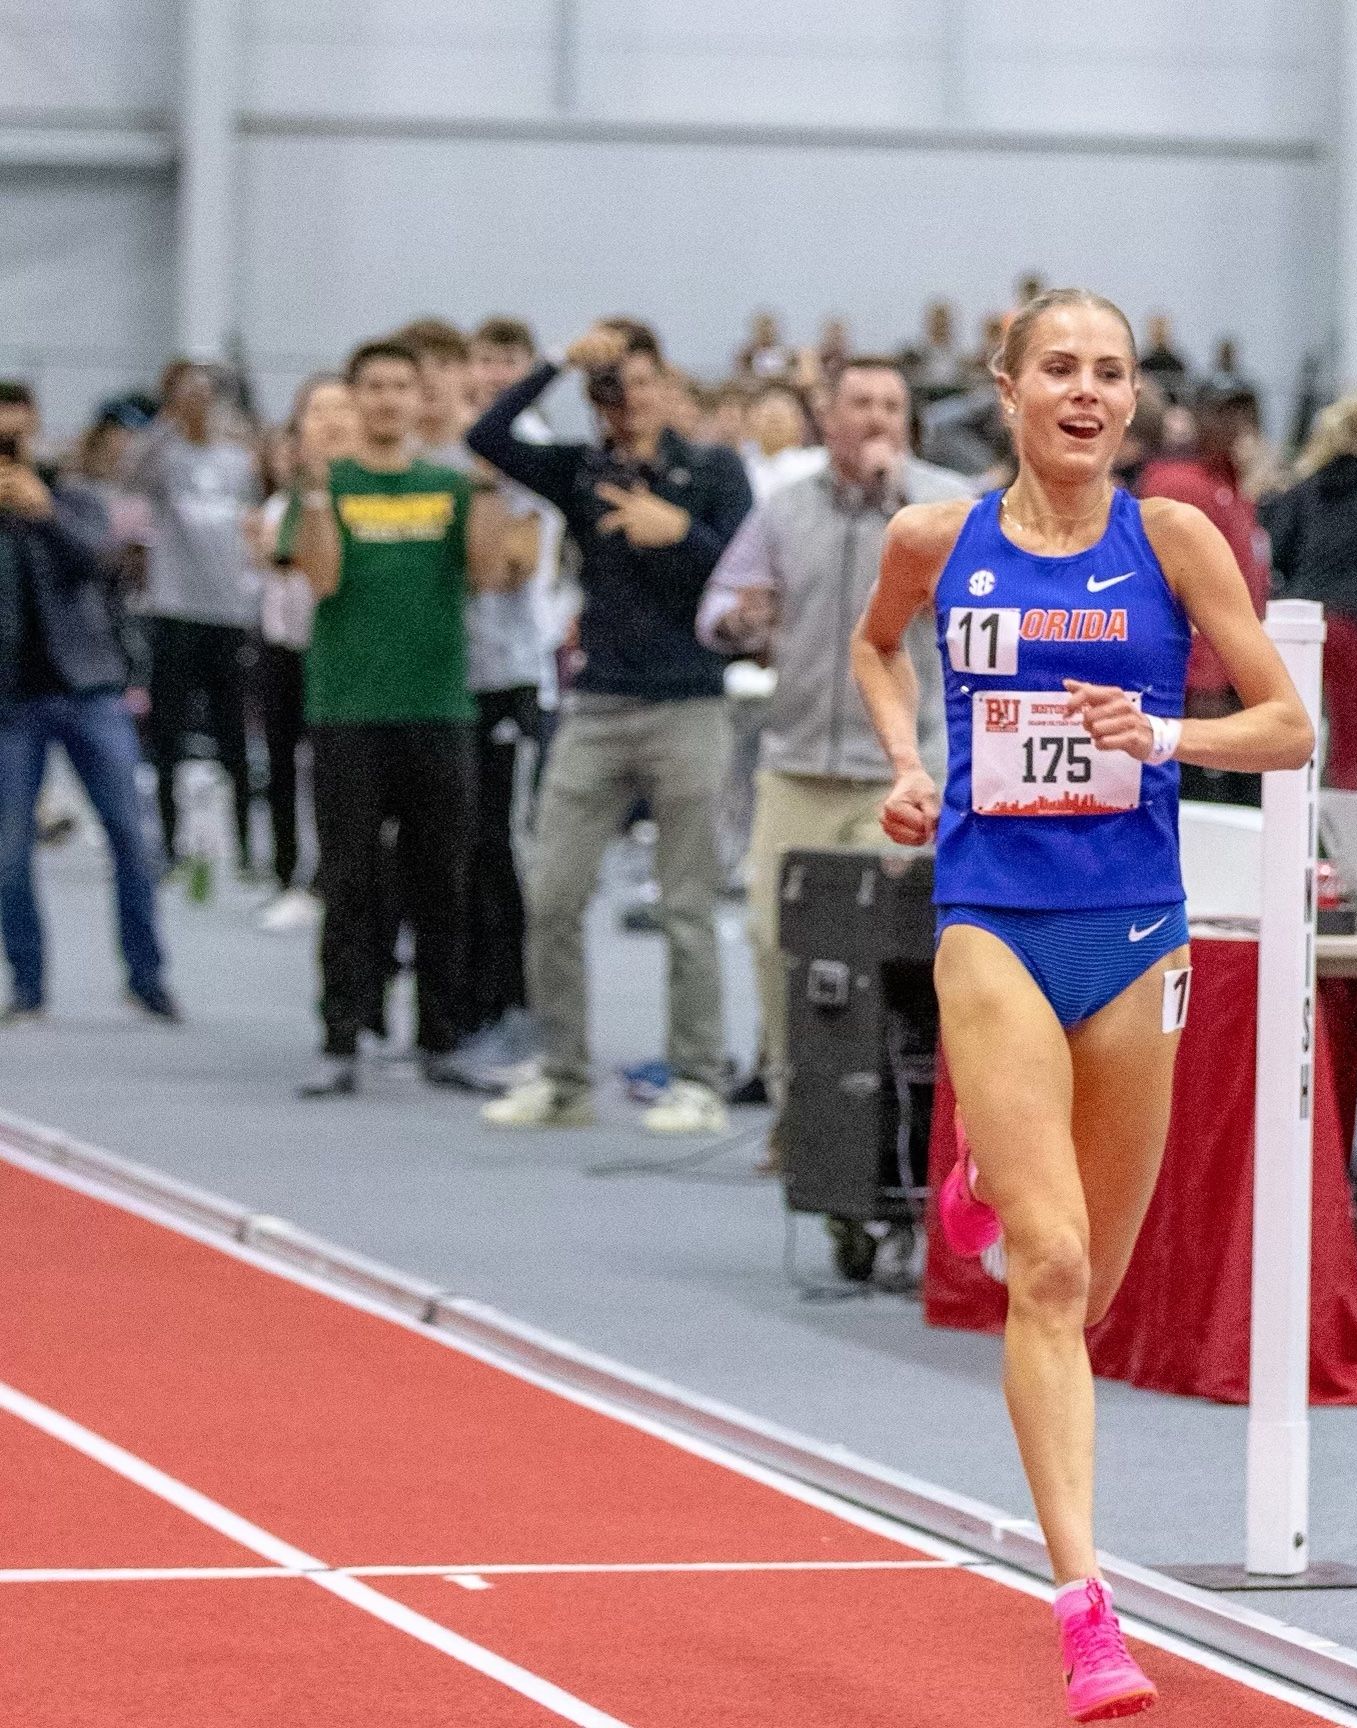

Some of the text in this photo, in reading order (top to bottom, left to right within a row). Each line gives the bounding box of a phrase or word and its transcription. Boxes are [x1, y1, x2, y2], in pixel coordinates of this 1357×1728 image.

[968, 570, 996, 597] SEC
[958, 611, 1000, 669] 11
[1019, 608, 1129, 642] ORIDA
[1022, 736, 1092, 783] 175
[1173, 971, 1189, 1025] 1
